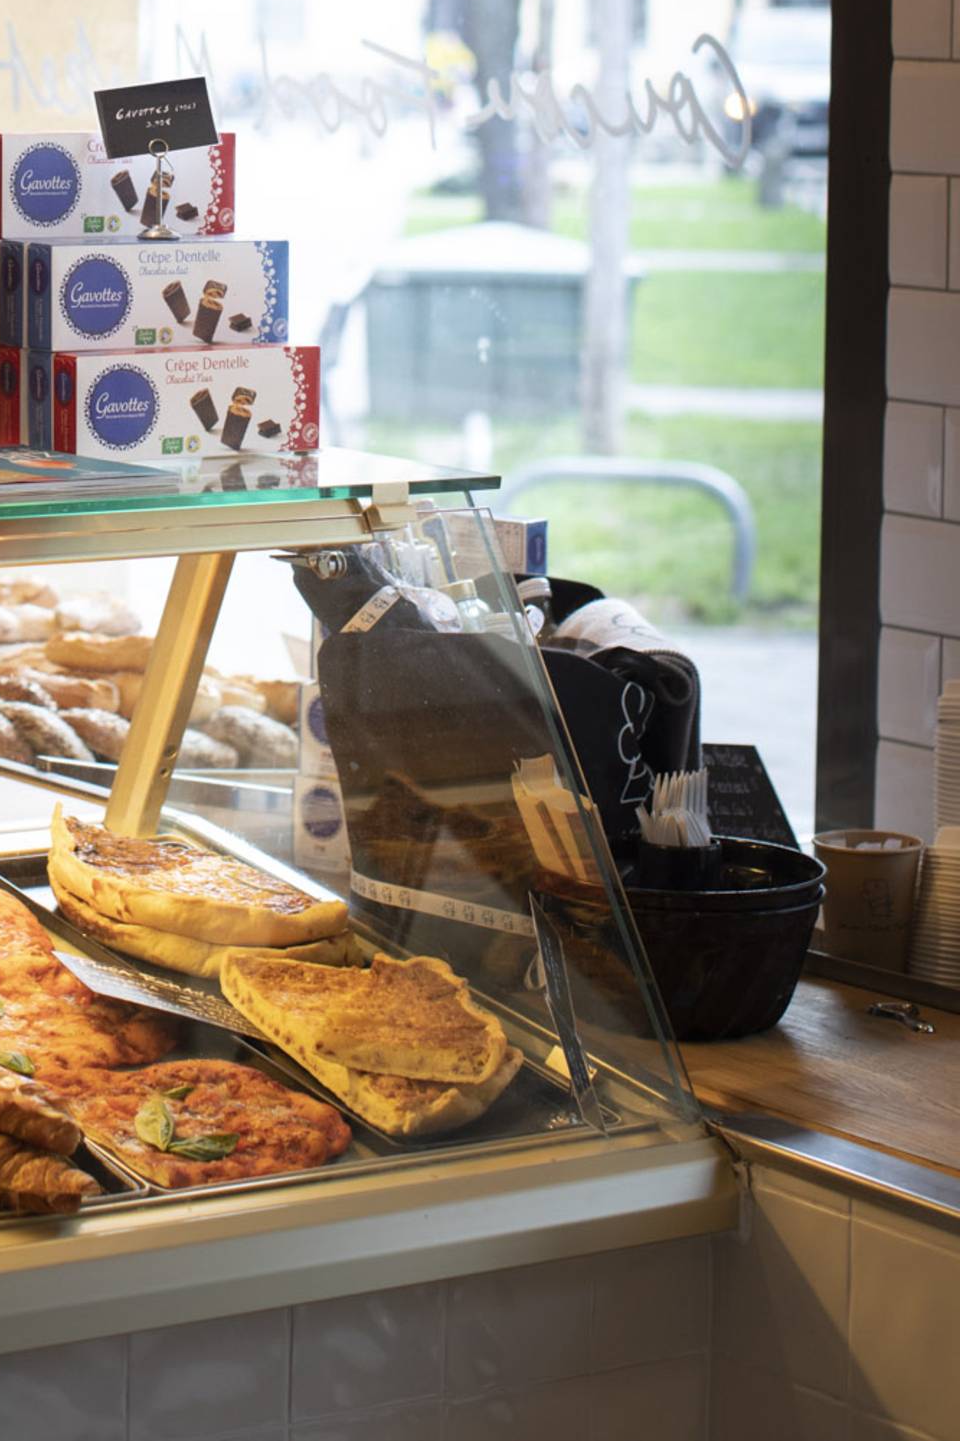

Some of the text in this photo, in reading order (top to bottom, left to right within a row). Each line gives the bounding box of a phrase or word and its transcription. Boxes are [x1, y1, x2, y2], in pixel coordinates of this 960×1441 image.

[115, 104, 170, 121] GAVOTTES
[20, 168, 73, 196] Gavottes
[138, 248, 221, 269] Crêpe Dentelle
[70, 281, 124, 309] Gavottes
[164, 355, 250, 377] Crêpe Dentelle
[95, 391, 151, 420] Gavottes
